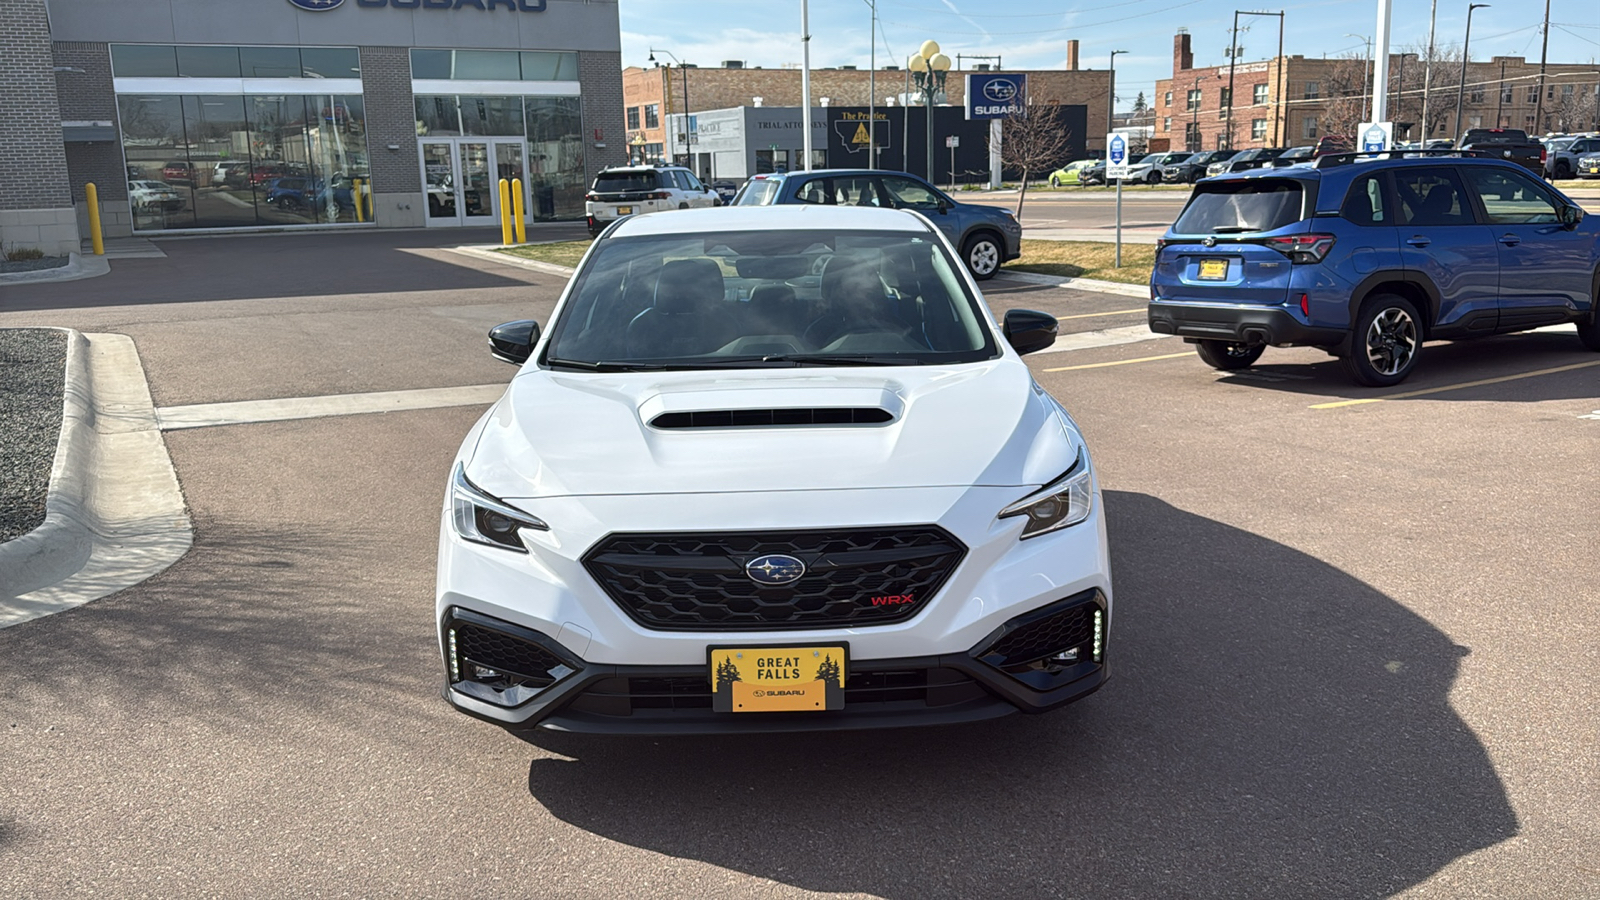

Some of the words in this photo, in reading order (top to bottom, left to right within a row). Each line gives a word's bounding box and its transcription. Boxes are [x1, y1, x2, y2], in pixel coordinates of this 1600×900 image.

[975, 106, 1023, 115] SUBARU
[841, 112, 856, 120] The
[857, 112, 887, 120] Pratice
[758, 121, 782, 129] TRIAL
[871, 594, 914, 606] WRX
[757, 657, 800, 668] GREAT
[757, 668, 800, 680] FALLS
